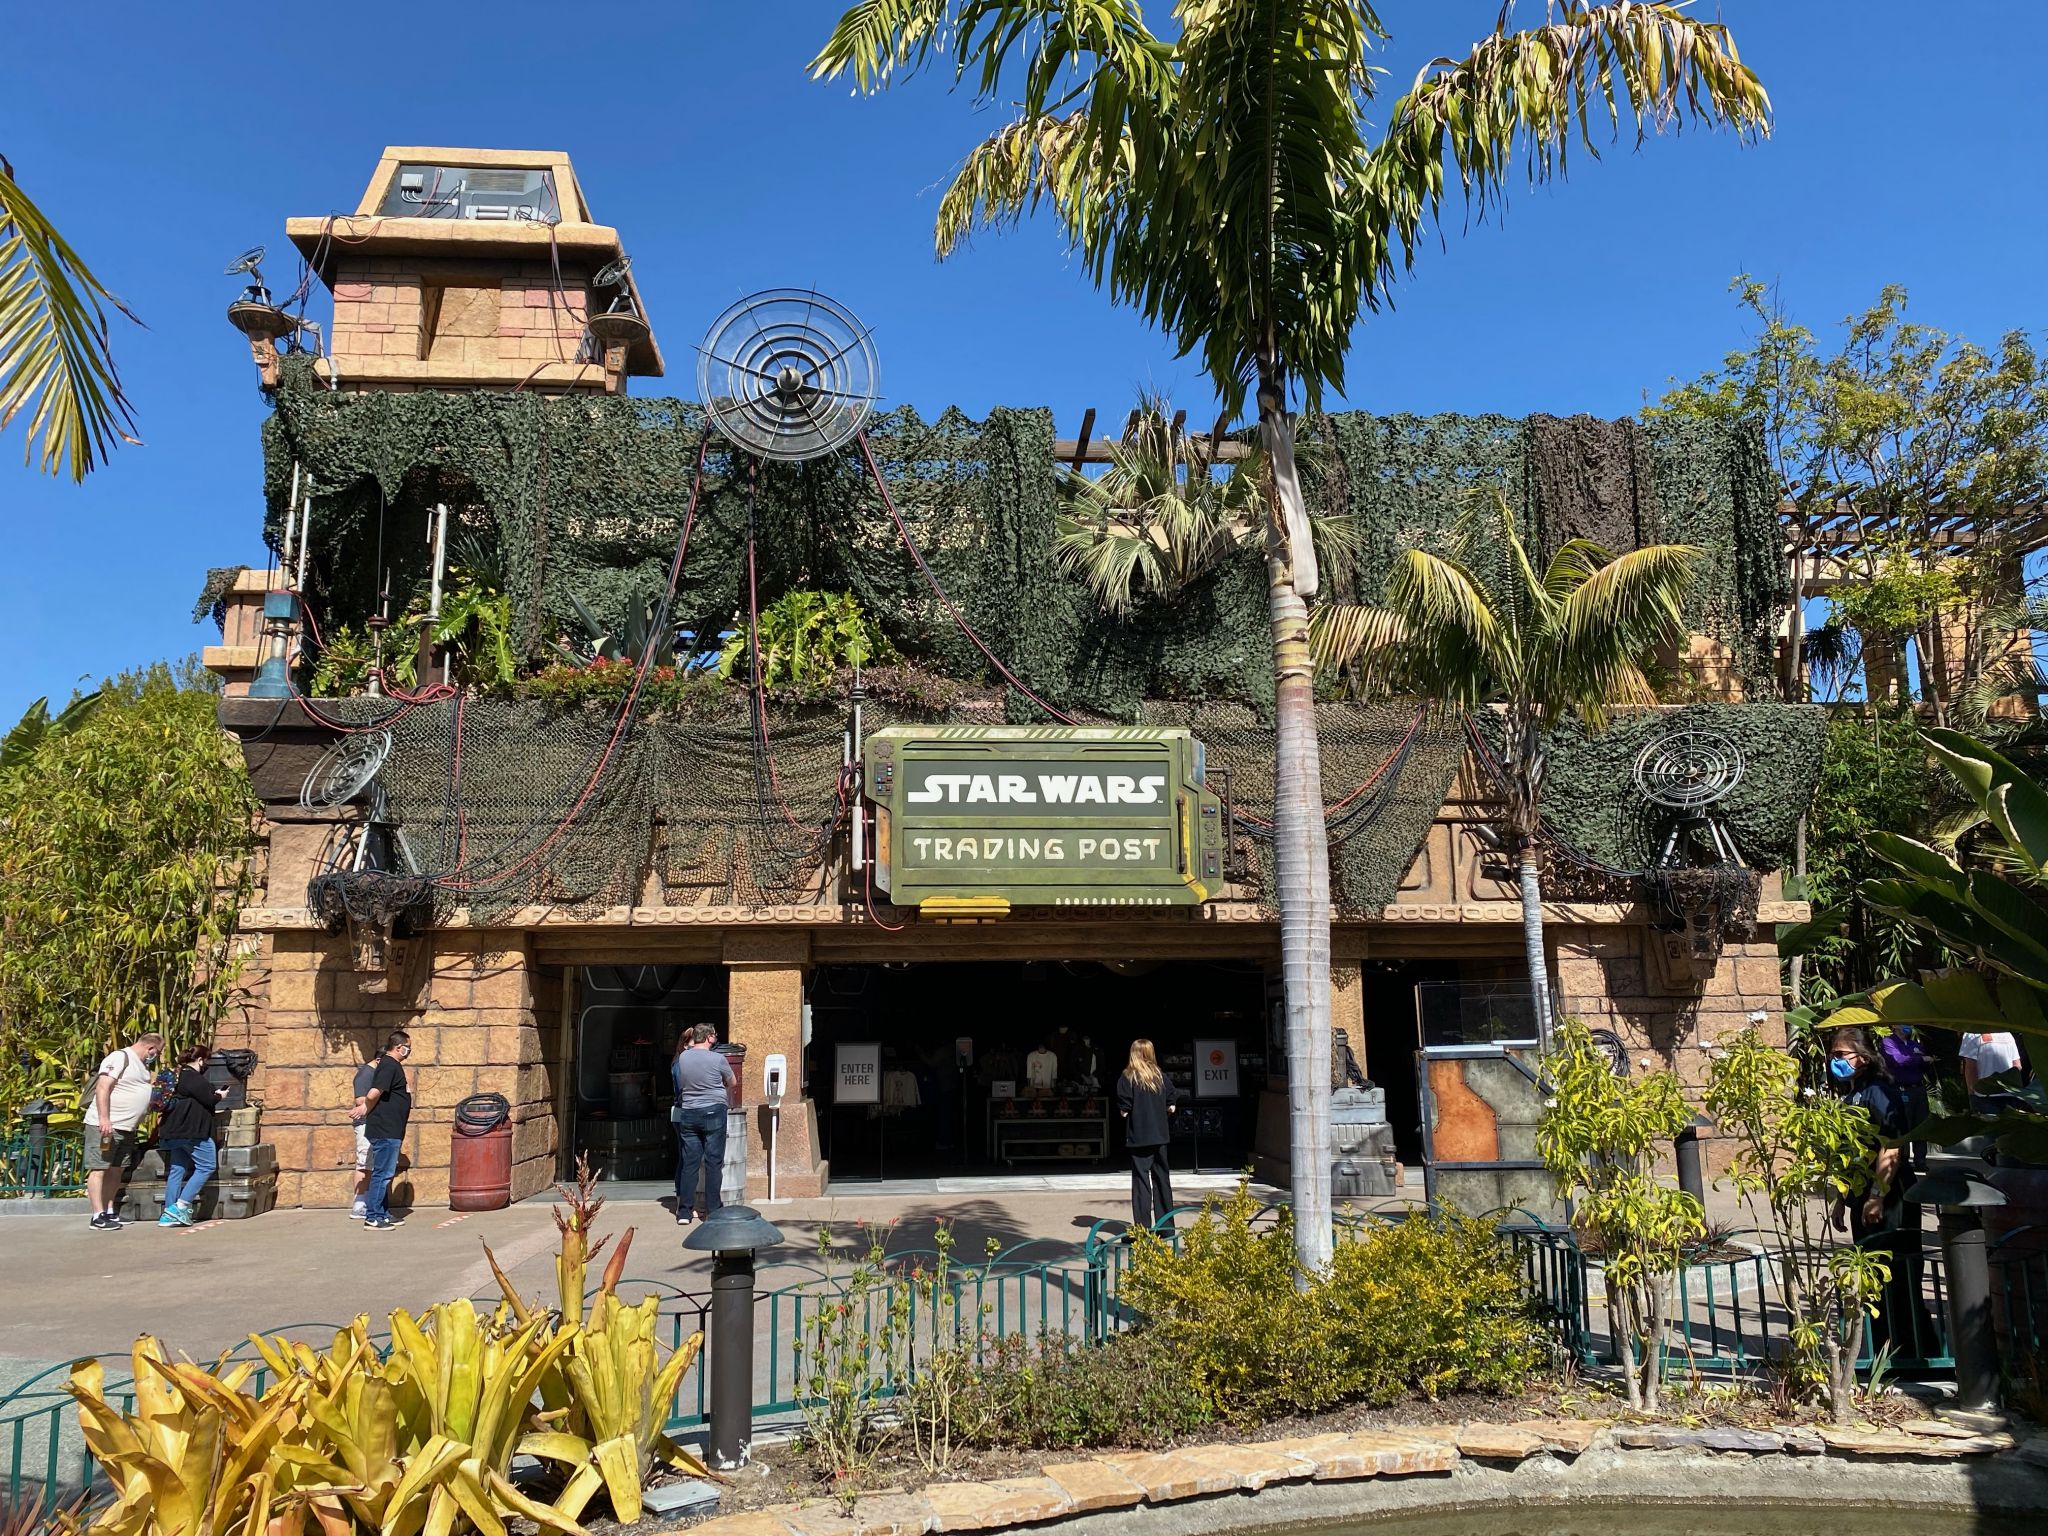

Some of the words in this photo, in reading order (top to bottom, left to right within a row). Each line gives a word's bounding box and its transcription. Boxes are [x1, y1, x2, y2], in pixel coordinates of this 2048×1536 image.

[907, 775, 1037, 803] STAR
[1037, 775, 1165, 803] WARS
[912, 837, 1065, 861] TRADING
[1078, 838, 1161, 861] POST
[841, 1063, 874, 1074] ENTER
[845, 1075, 870, 1085] HERE
[1204, 1069, 1229, 1081] EXIT
